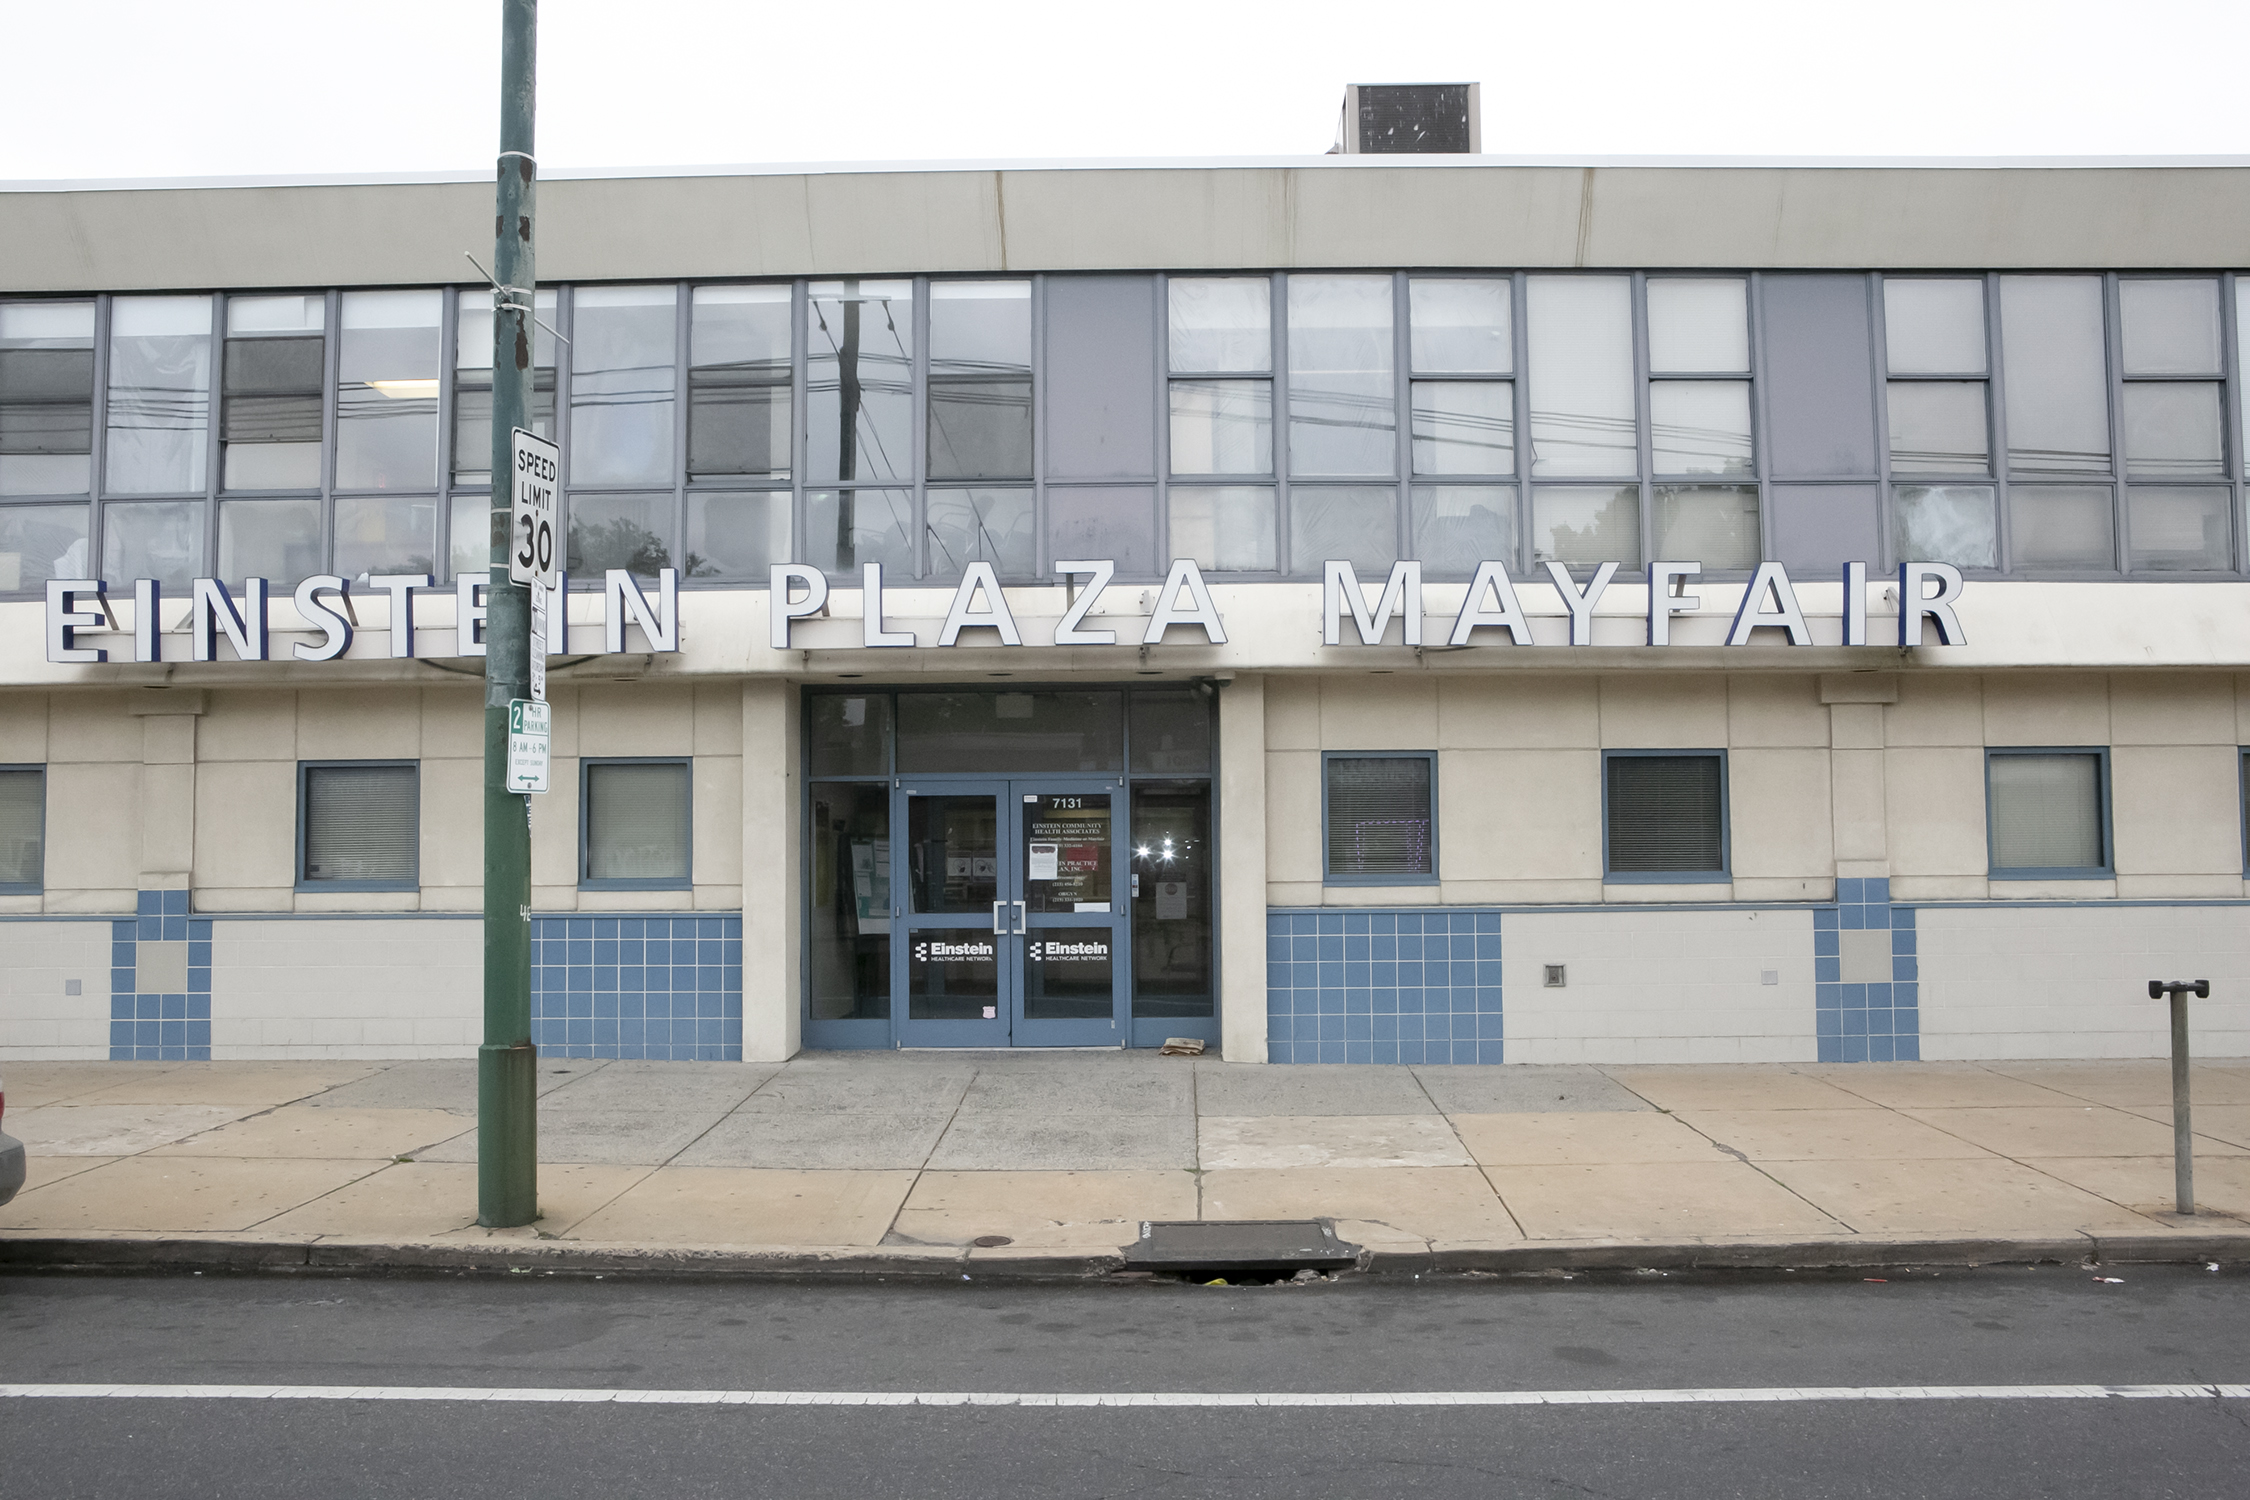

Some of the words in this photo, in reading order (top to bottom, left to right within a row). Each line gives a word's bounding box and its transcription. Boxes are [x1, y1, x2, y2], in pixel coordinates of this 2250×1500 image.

[518, 449, 556, 482] SPEED
[521, 481, 552, 511] LIMIT
[518, 513, 552, 573] 30
[45, 566, 679, 663] EINSTEIN
[770, 558, 1228, 649] PLAZA
[1322, 559, 1967, 647] MAYFAIR
[513, 706, 521, 729] 2
[531, 707, 542, 718] HR
[523, 720, 548, 733] PARKING
[512, 741, 517, 752] 8
[538, 743, 546, 754] PM
[1052, 798, 1081, 809] 7131
[931, 942, 993, 955] Einstein
[1045, 942, 1107, 955] Einstein
